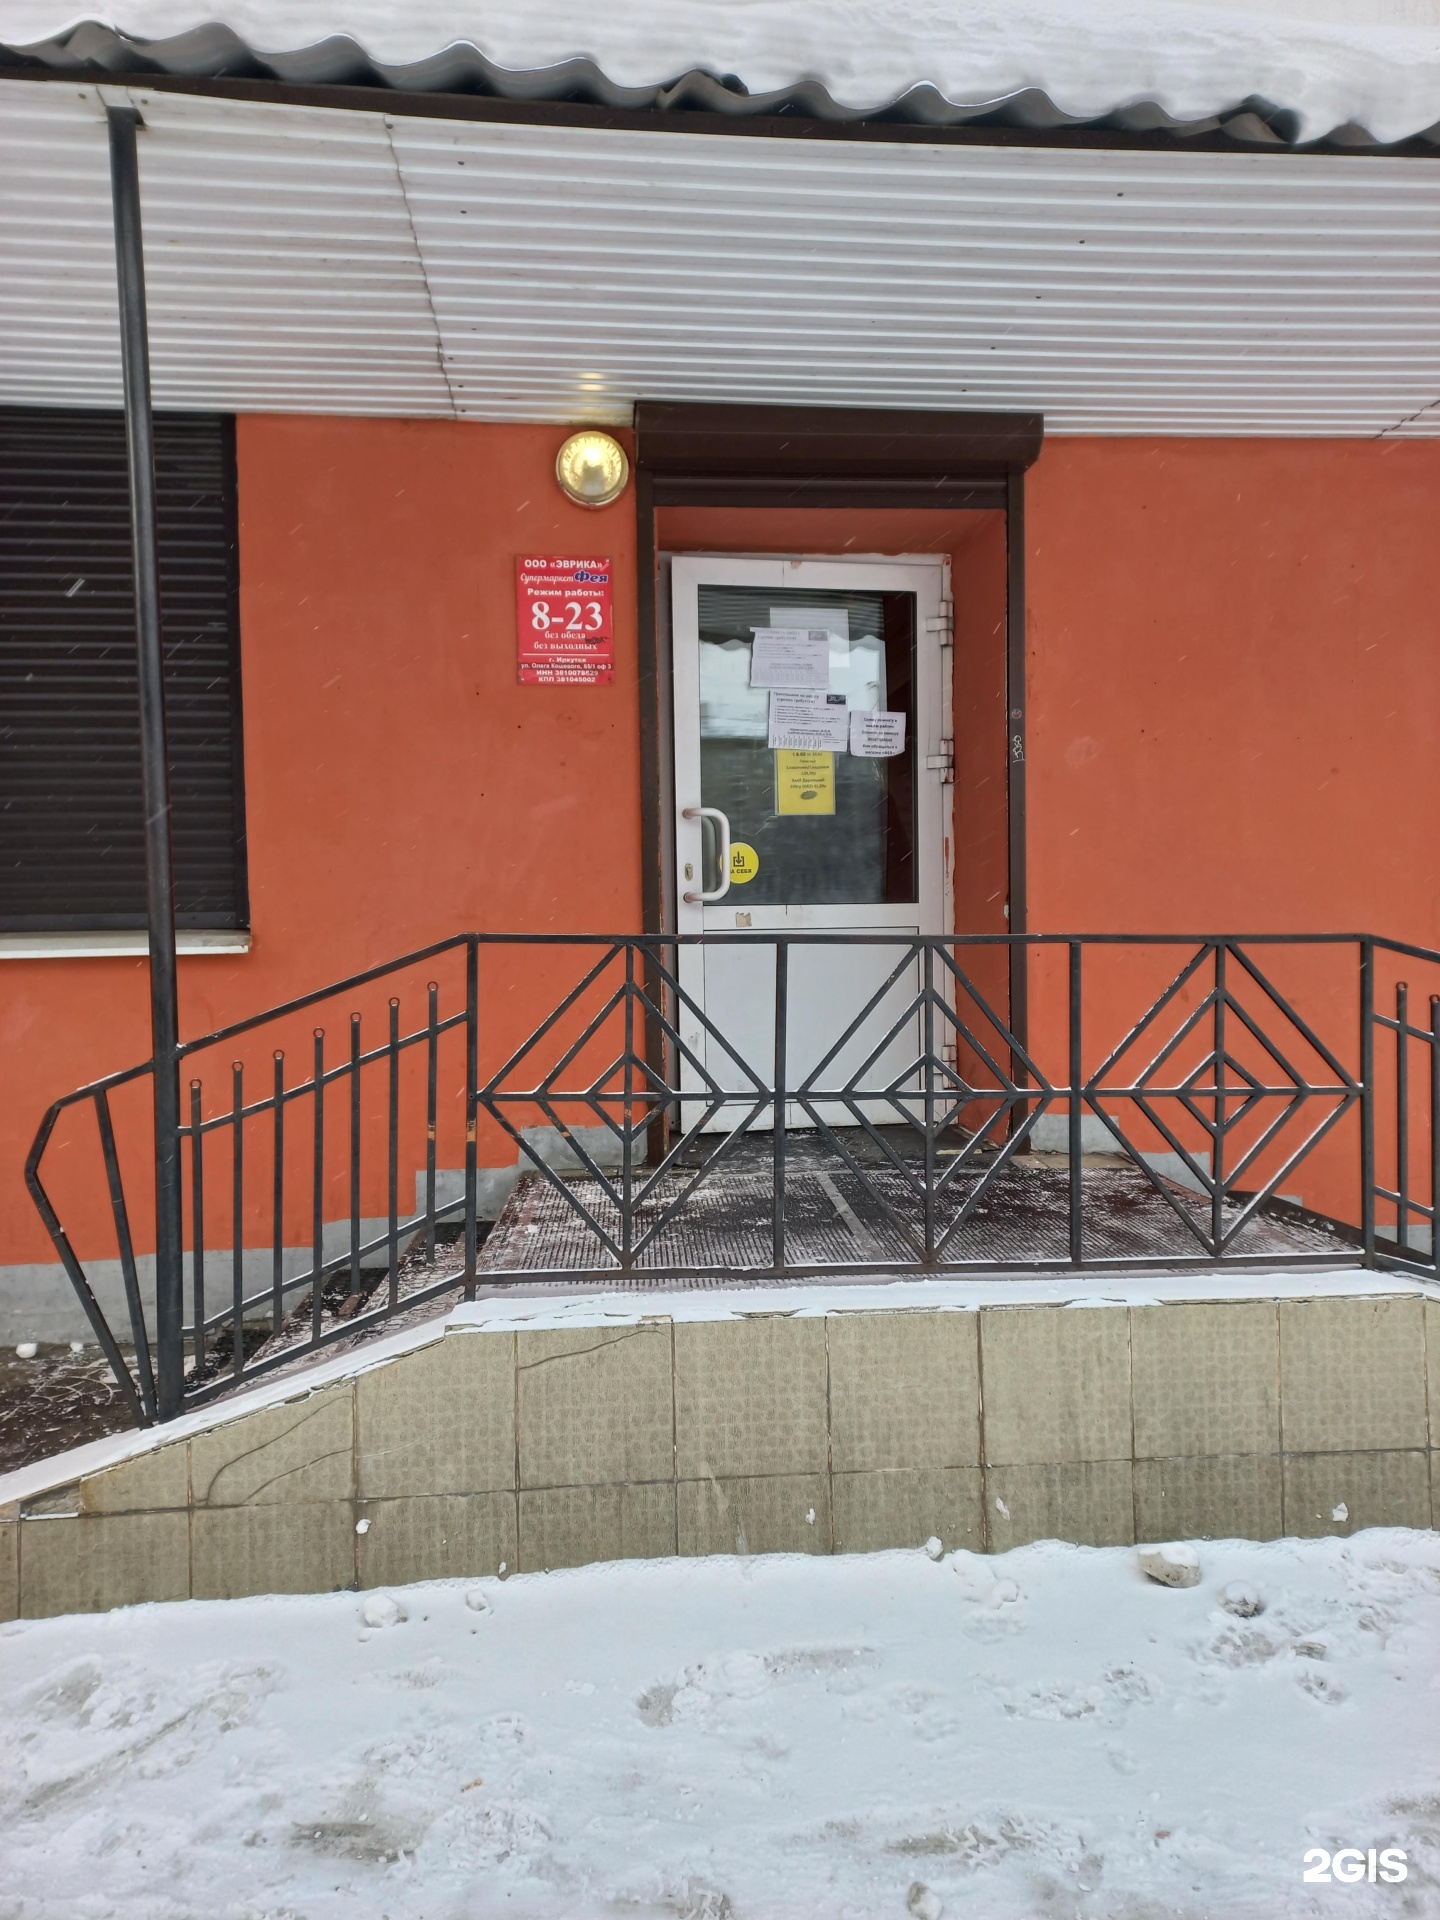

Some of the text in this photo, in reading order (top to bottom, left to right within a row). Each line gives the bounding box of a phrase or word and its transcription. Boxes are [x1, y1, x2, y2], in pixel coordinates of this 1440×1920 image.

[524, 559, 603, 569] ООО «ЭВРИКА»
[520, 569, 609, 585] Супермаркет Фея
[527, 588, 604, 597] Режим работы:
[531, 601, 603, 631] 8-23
[545, 630, 586, 639] без обеда
[534, 641, 597, 650] без выходных
[556, 656, 587, 664] Иркутск
